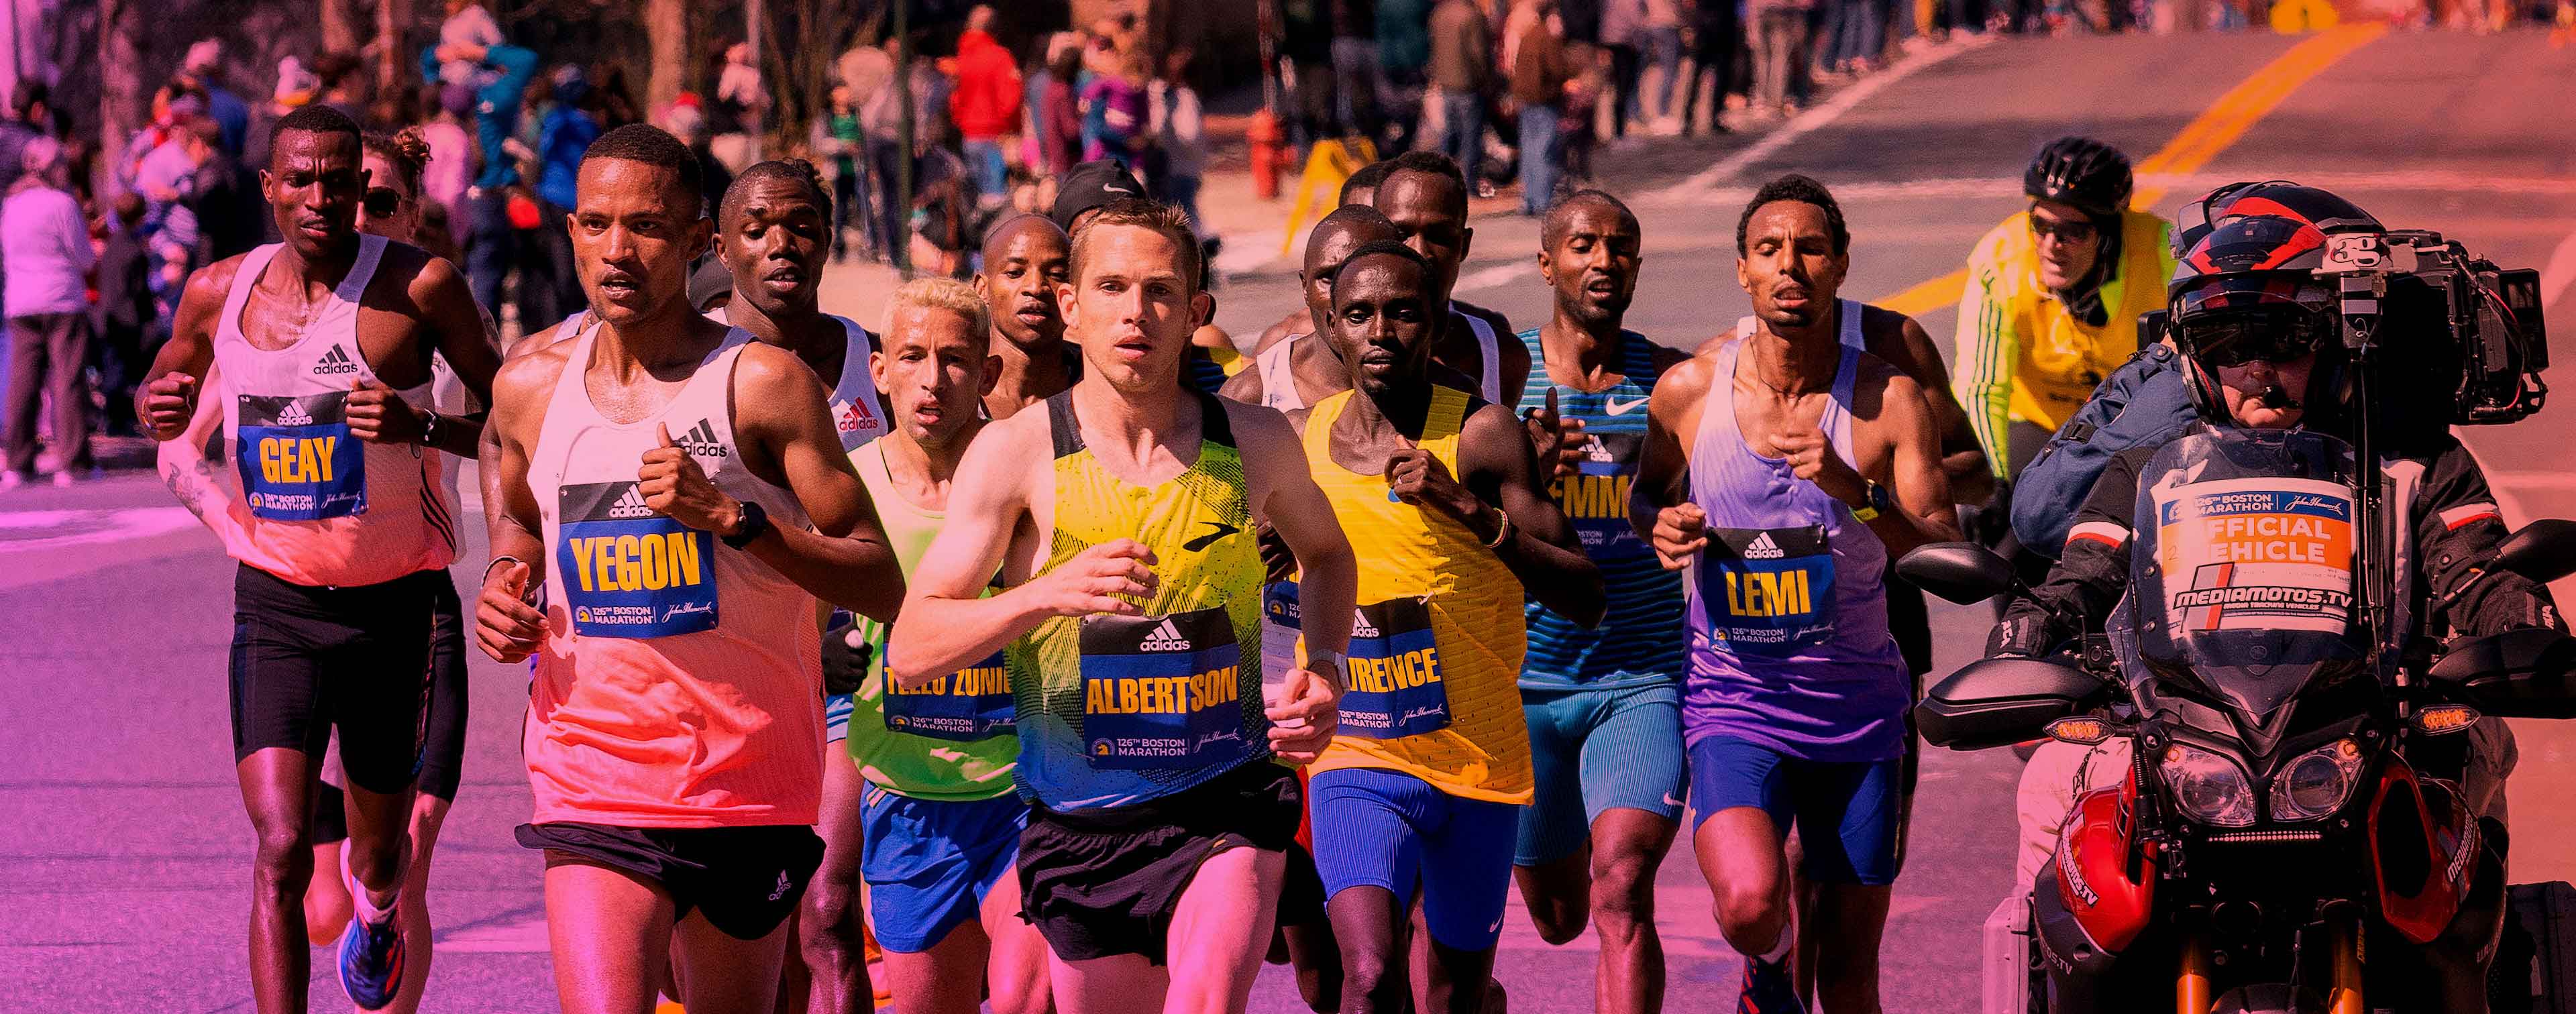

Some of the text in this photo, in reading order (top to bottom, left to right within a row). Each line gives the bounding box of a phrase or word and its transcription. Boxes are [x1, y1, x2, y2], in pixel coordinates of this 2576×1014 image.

[313, 363, 358, 374] adidas
[276, 414, 313, 427] adidas
[839, 418, 878, 431] adidas
[259, 436, 336, 484] GEAY
[279, 494, 312, 504] BOSTON
[2222, 494, 2271, 504] BOSTON
[265, 502, 315, 510] MARATHON
[609, 505, 653, 517] adidas
[2206, 517, 2331, 539] FFICIAL
[1745, 549, 1784, 559] adidas
[2210, 541, 2325, 562] EHICLE
[570, 532, 700, 591] YEGON
[1725, 569, 1811, 617] LEMI
[2176, 587, 2353, 608] MEDIAMOTOS.TV
[613, 606, 651, 615] BOSTON
[594, 616, 653, 624] MARATHON
[1751, 628, 1784, 636] BOSTON
[1733, 635, 1785, 643] MARATHON
[1140, 638, 1191, 652] adidas
[1086, 665, 1238, 714] ALBERTSON
[1355, 712, 1389, 720] BOSTON
[933, 717, 972, 726] BOSTON
[1342, 718, 1391, 728] MARATHON
[913, 723, 974, 733] MARATHON
[1117, 738, 1140, 746] 126TH
[1142, 738, 1185, 747] BOSTON
[1118, 747, 1186, 756] MARATHON
